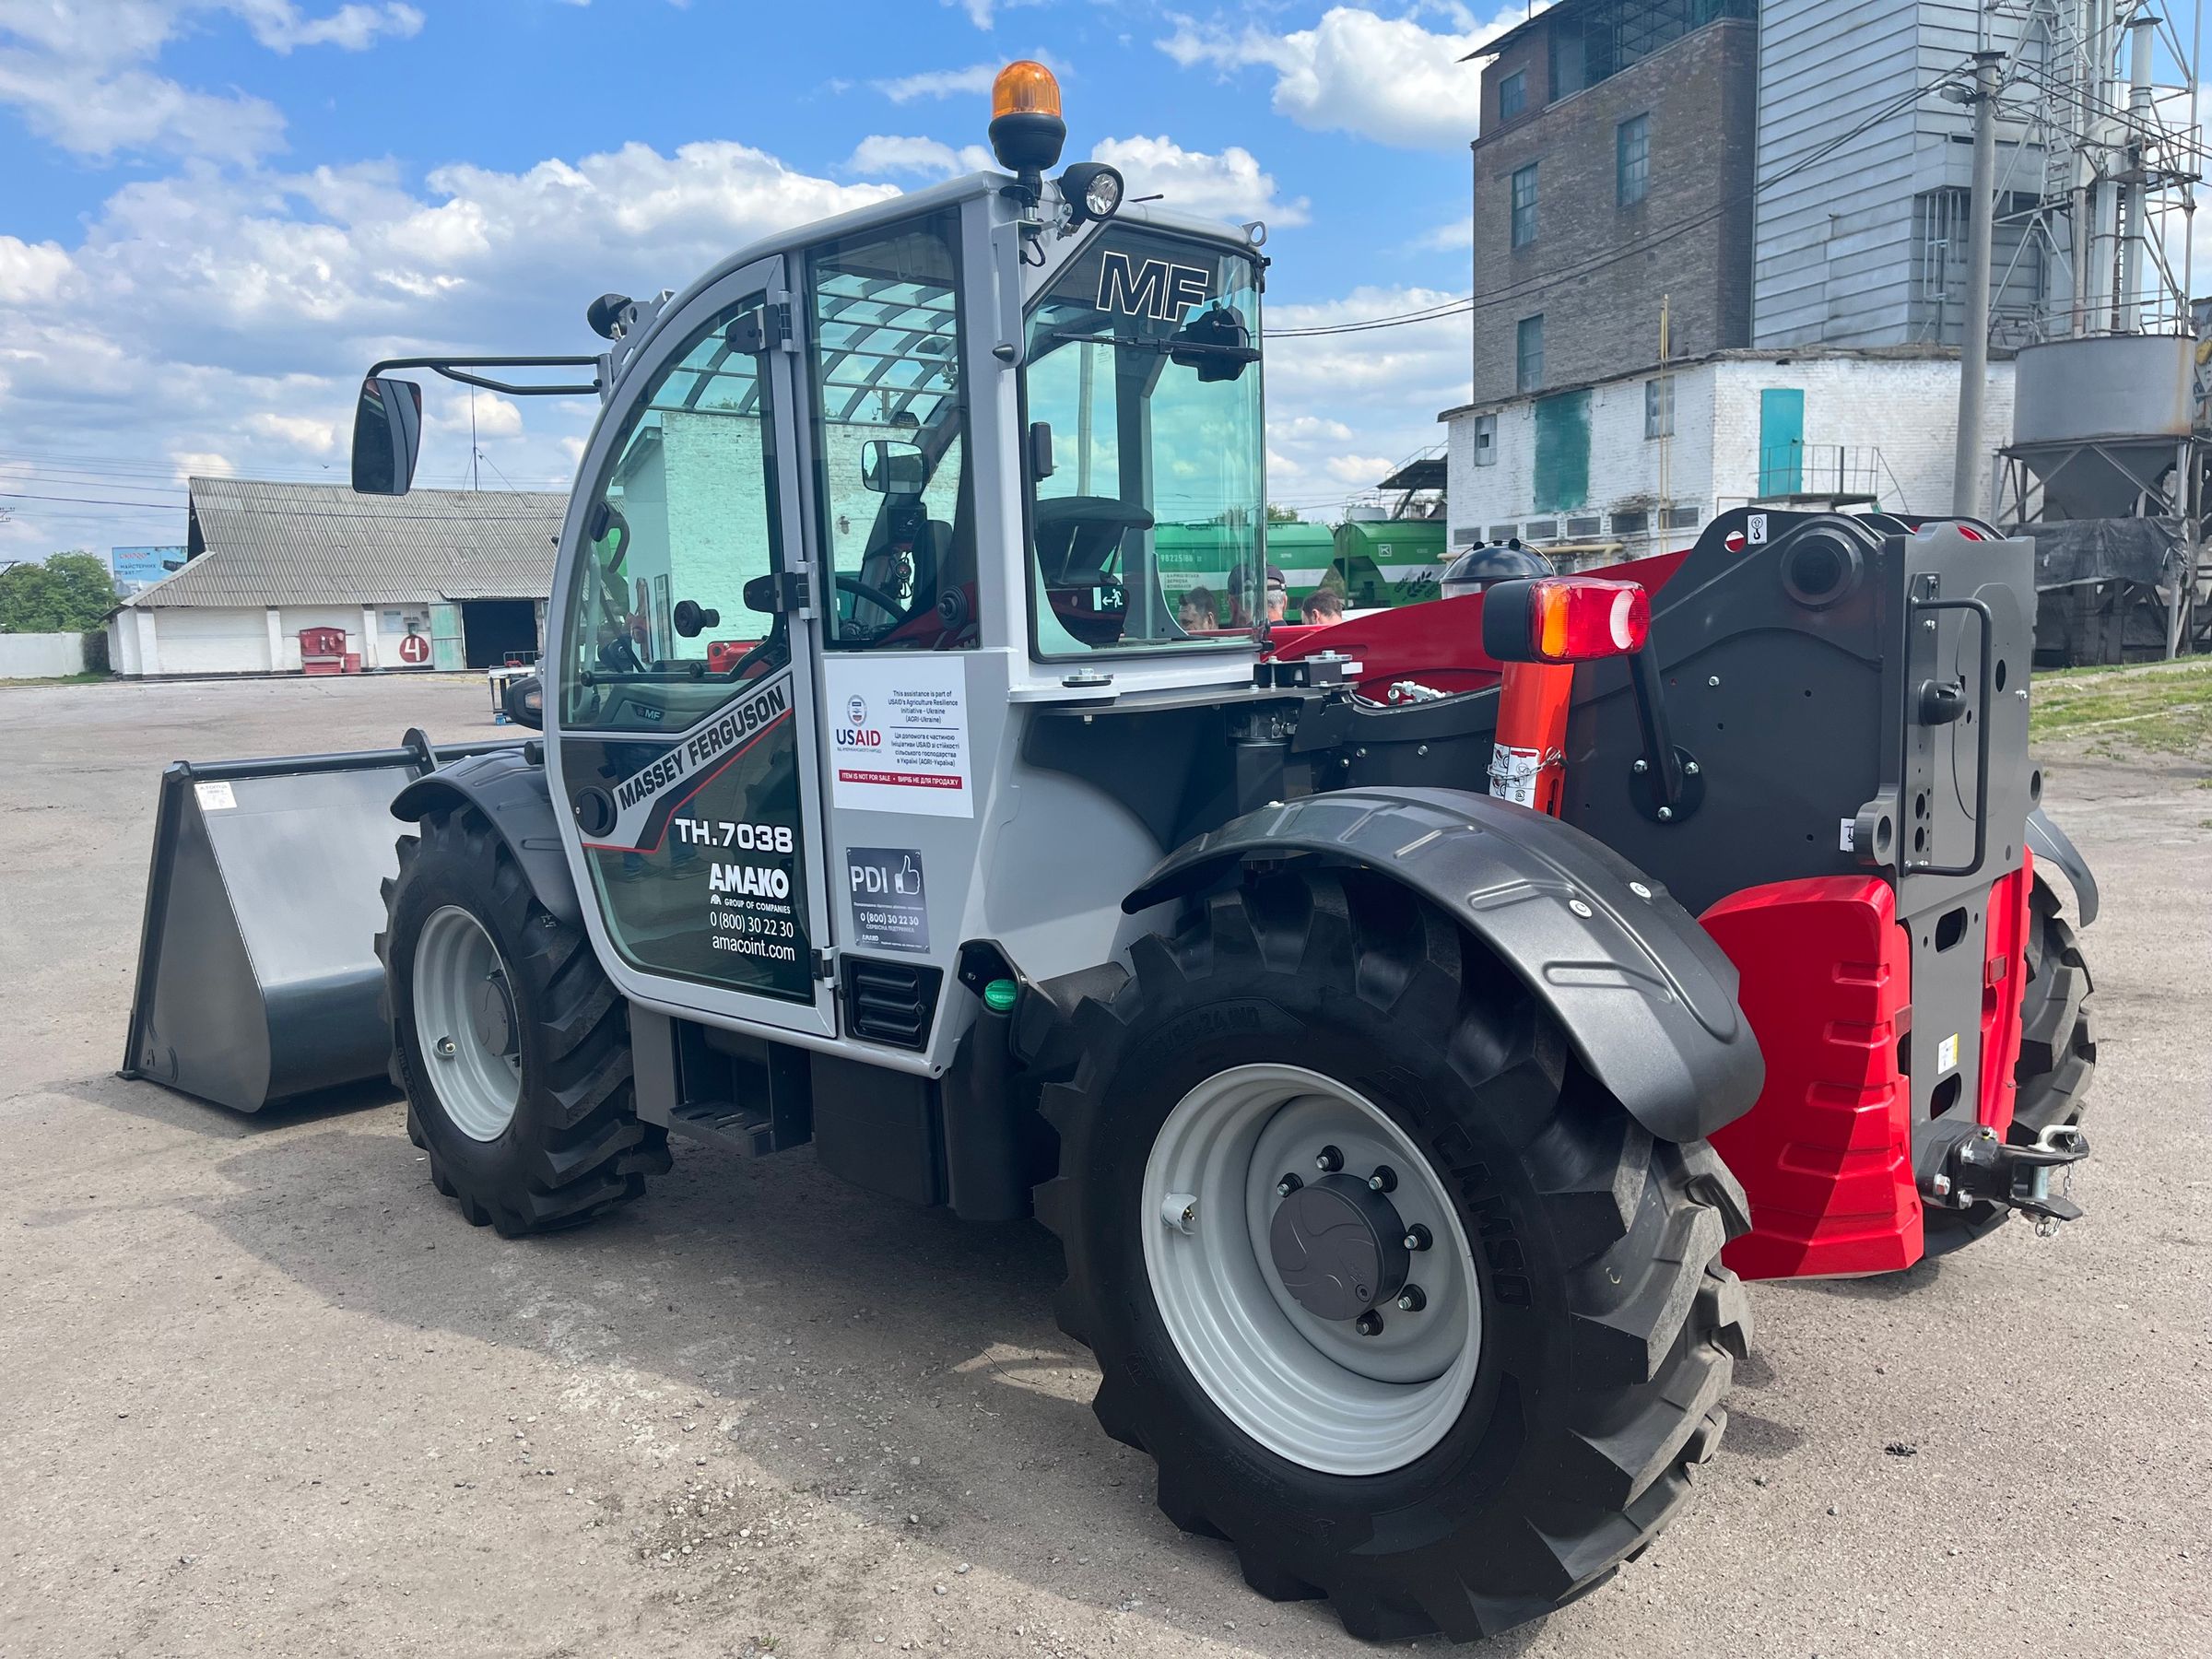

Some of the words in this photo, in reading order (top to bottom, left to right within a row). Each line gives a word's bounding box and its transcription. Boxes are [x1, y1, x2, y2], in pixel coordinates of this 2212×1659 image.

[1096, 251, 1209, 322] MF
[405, 638, 421, 662] 4
[644, 709, 661, 720] MF
[618, 748, 684, 811] MASSEY
[687, 685, 786, 767] FERGUSON
[836, 728, 881, 747] USAID
[674, 818, 794, 853] TH.7038
[709, 862, 790, 900] AMAKO
[850, 865, 888, 894] PDI
[724, 898, 745, 908] GROUP
[746, 900, 755, 909] OF
[756, 902, 791, 914] COMPANIES
[860, 912, 865, 922] 0
[866, 912, 886, 924] (800)
[888, 914, 898, 924] 30
[899, 916, 908, 924] 22
[909, 916, 919, 925] 30
[710, 912, 717, 926] 0
[719, 912, 746, 933] (800)
[747, 916, 761, 933] 30
[764, 919, 778, 935] 22
[780, 921, 794, 938] 30
[712, 935, 795, 961] amacoint.com
